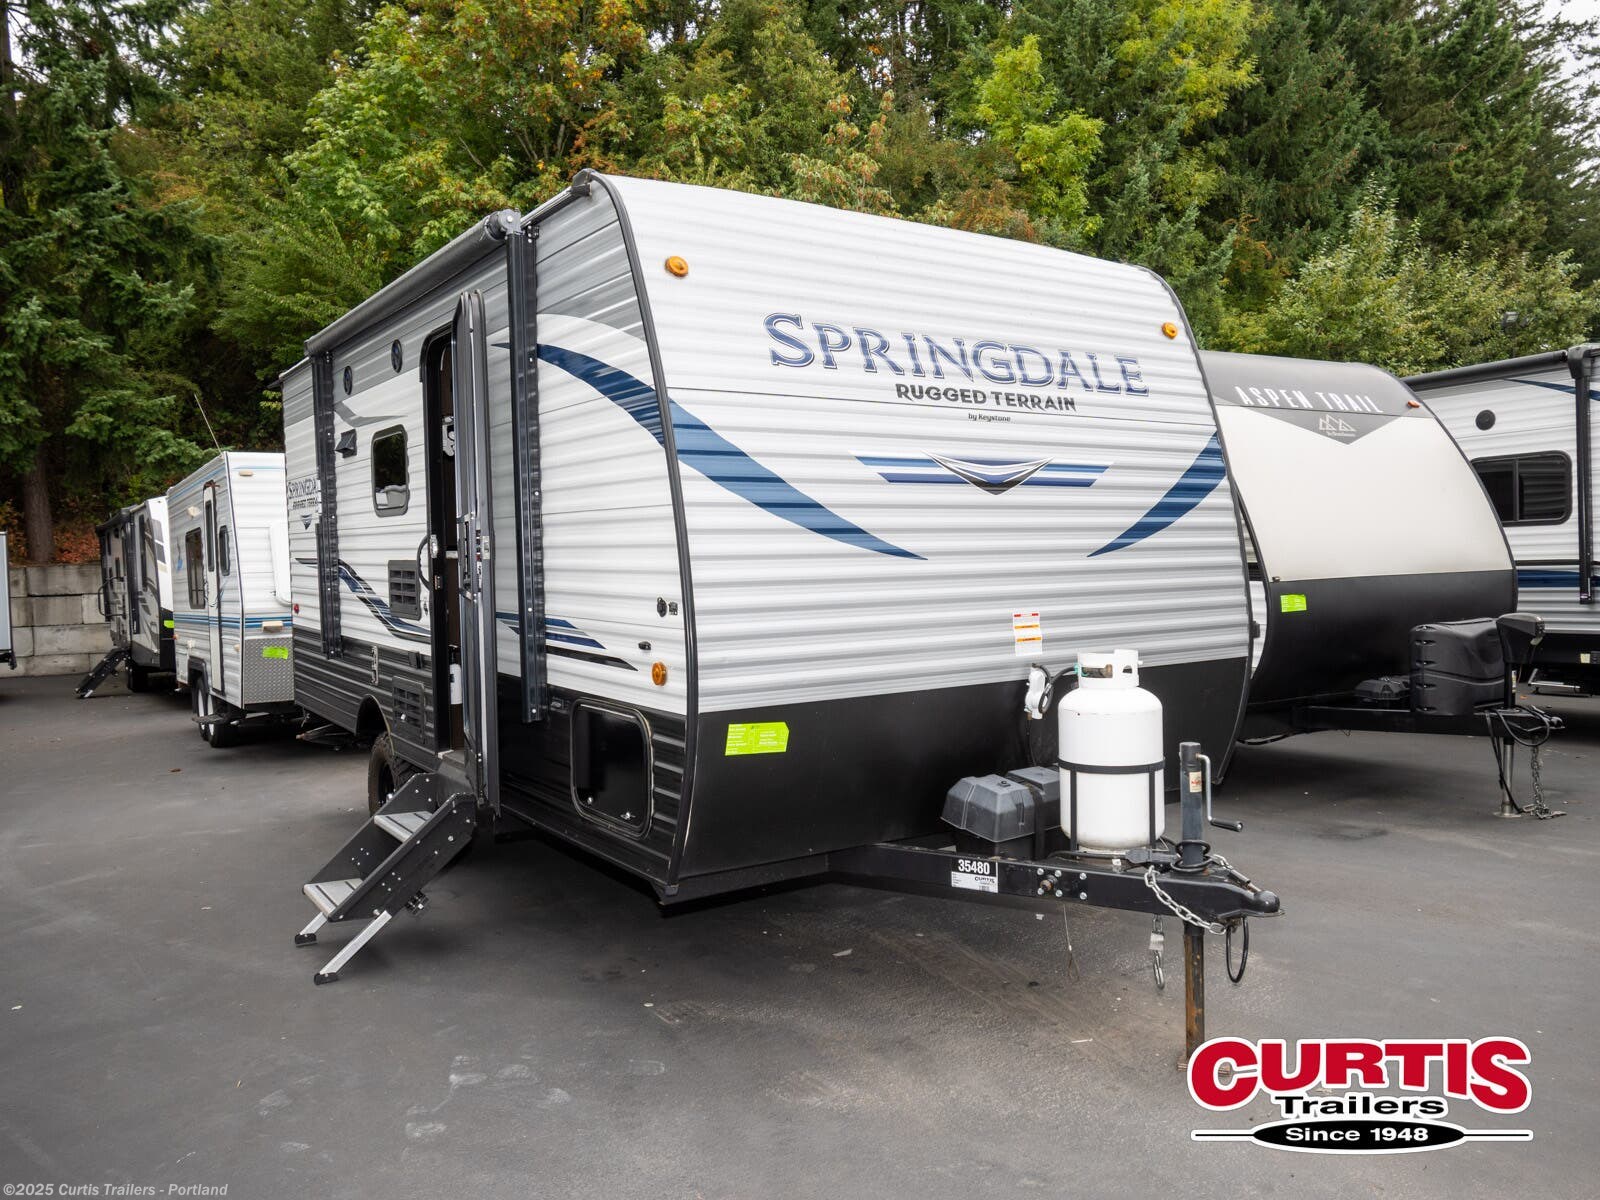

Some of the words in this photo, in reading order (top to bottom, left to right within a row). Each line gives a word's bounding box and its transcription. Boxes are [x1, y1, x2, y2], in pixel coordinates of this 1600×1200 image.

[763, 312, 1149, 397] SPRINGDALE
[895, 383, 987, 405] RUGGED
[990, 391, 1077, 412] TERRAIN
[1234, 386, 1314, 409] ASPEN
[1315, 391, 1384, 413] TRAIL
[968, 413, 978, 422] by
[978, 414, 1011, 423] Keystone
[958, 859, 991, 875] 35480
